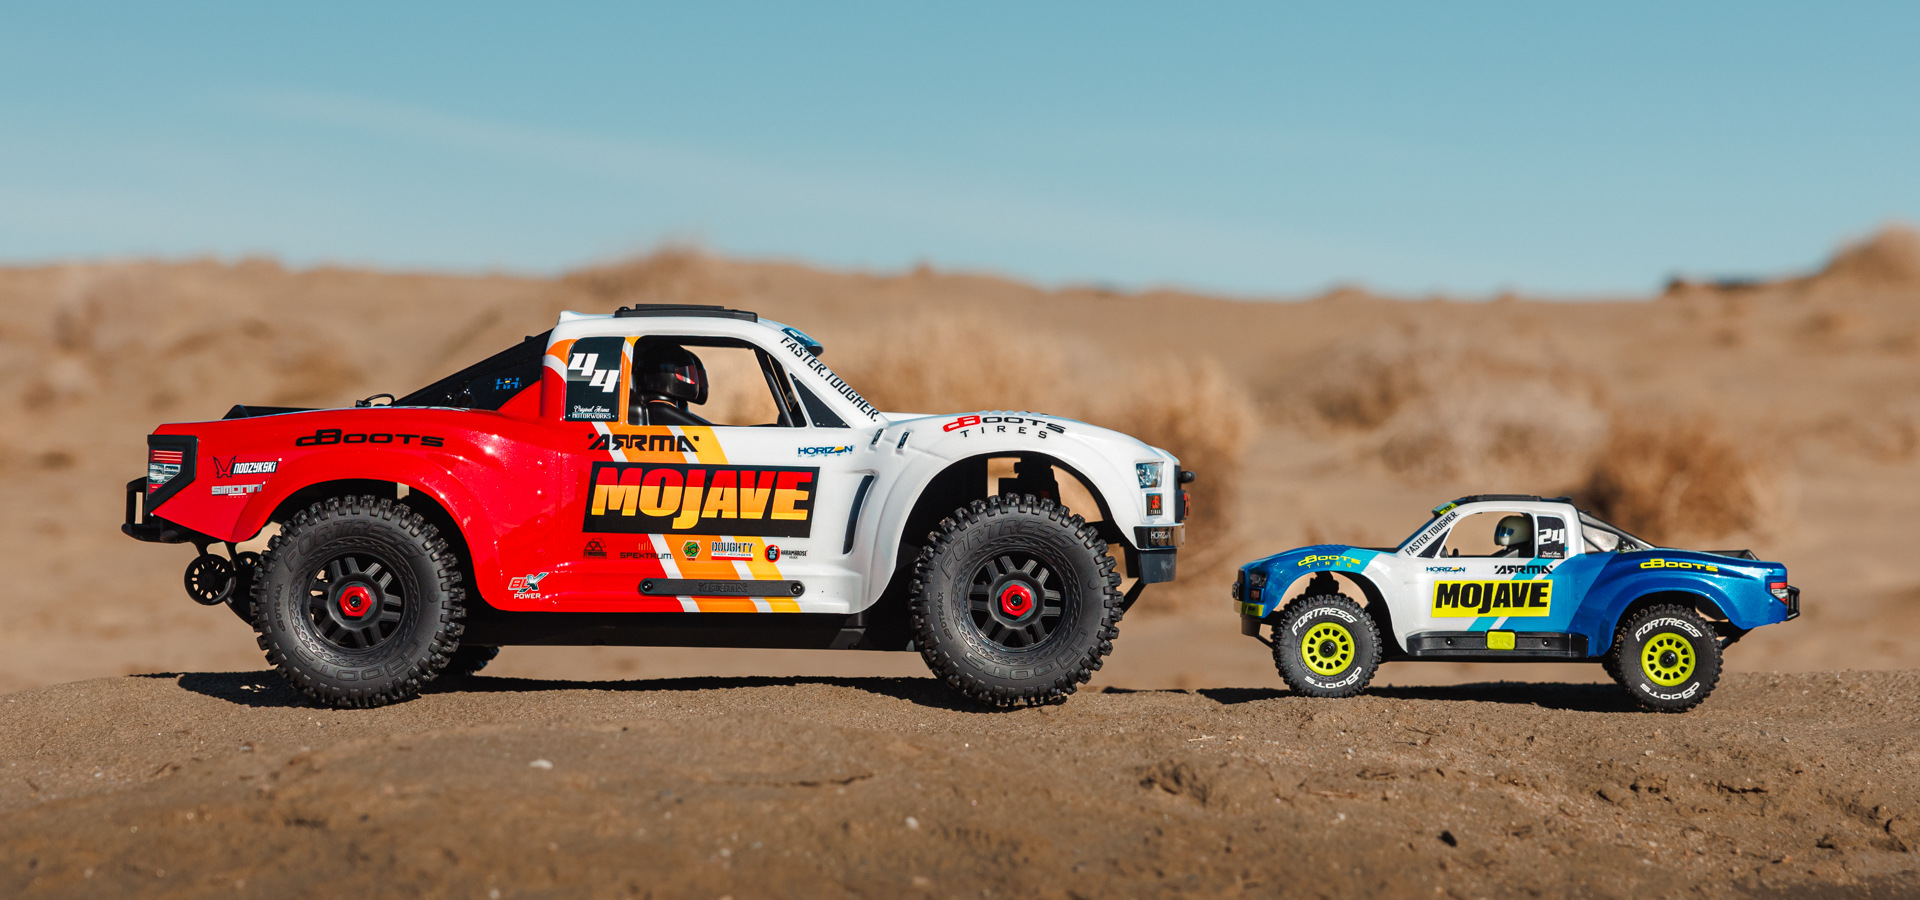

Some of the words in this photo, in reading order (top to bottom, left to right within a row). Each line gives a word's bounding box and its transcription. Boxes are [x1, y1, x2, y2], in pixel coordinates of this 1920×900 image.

[567, 353, 620, 393] 44
[587, 433, 699, 453] ARRMA
[960, 425, 1047, 439] TIRES
[797, 445, 854, 455] HORIZON
[591, 466, 813, 530] MOJAVE
[284, 519, 425, 572] FORTRESS
[711, 541, 753, 553] DOUGHTY
[1538, 528, 1565, 546] 24
[941, 519, 1079, 580] FORTRESS
[1494, 565, 1553, 574] ARRMA
[508, 572, 549, 593] BLX
[1435, 582, 1549, 614] MOJAVE
[1291, 607, 1357, 636] FORTRESS
[1635, 617, 1703, 642] FORTRESS
